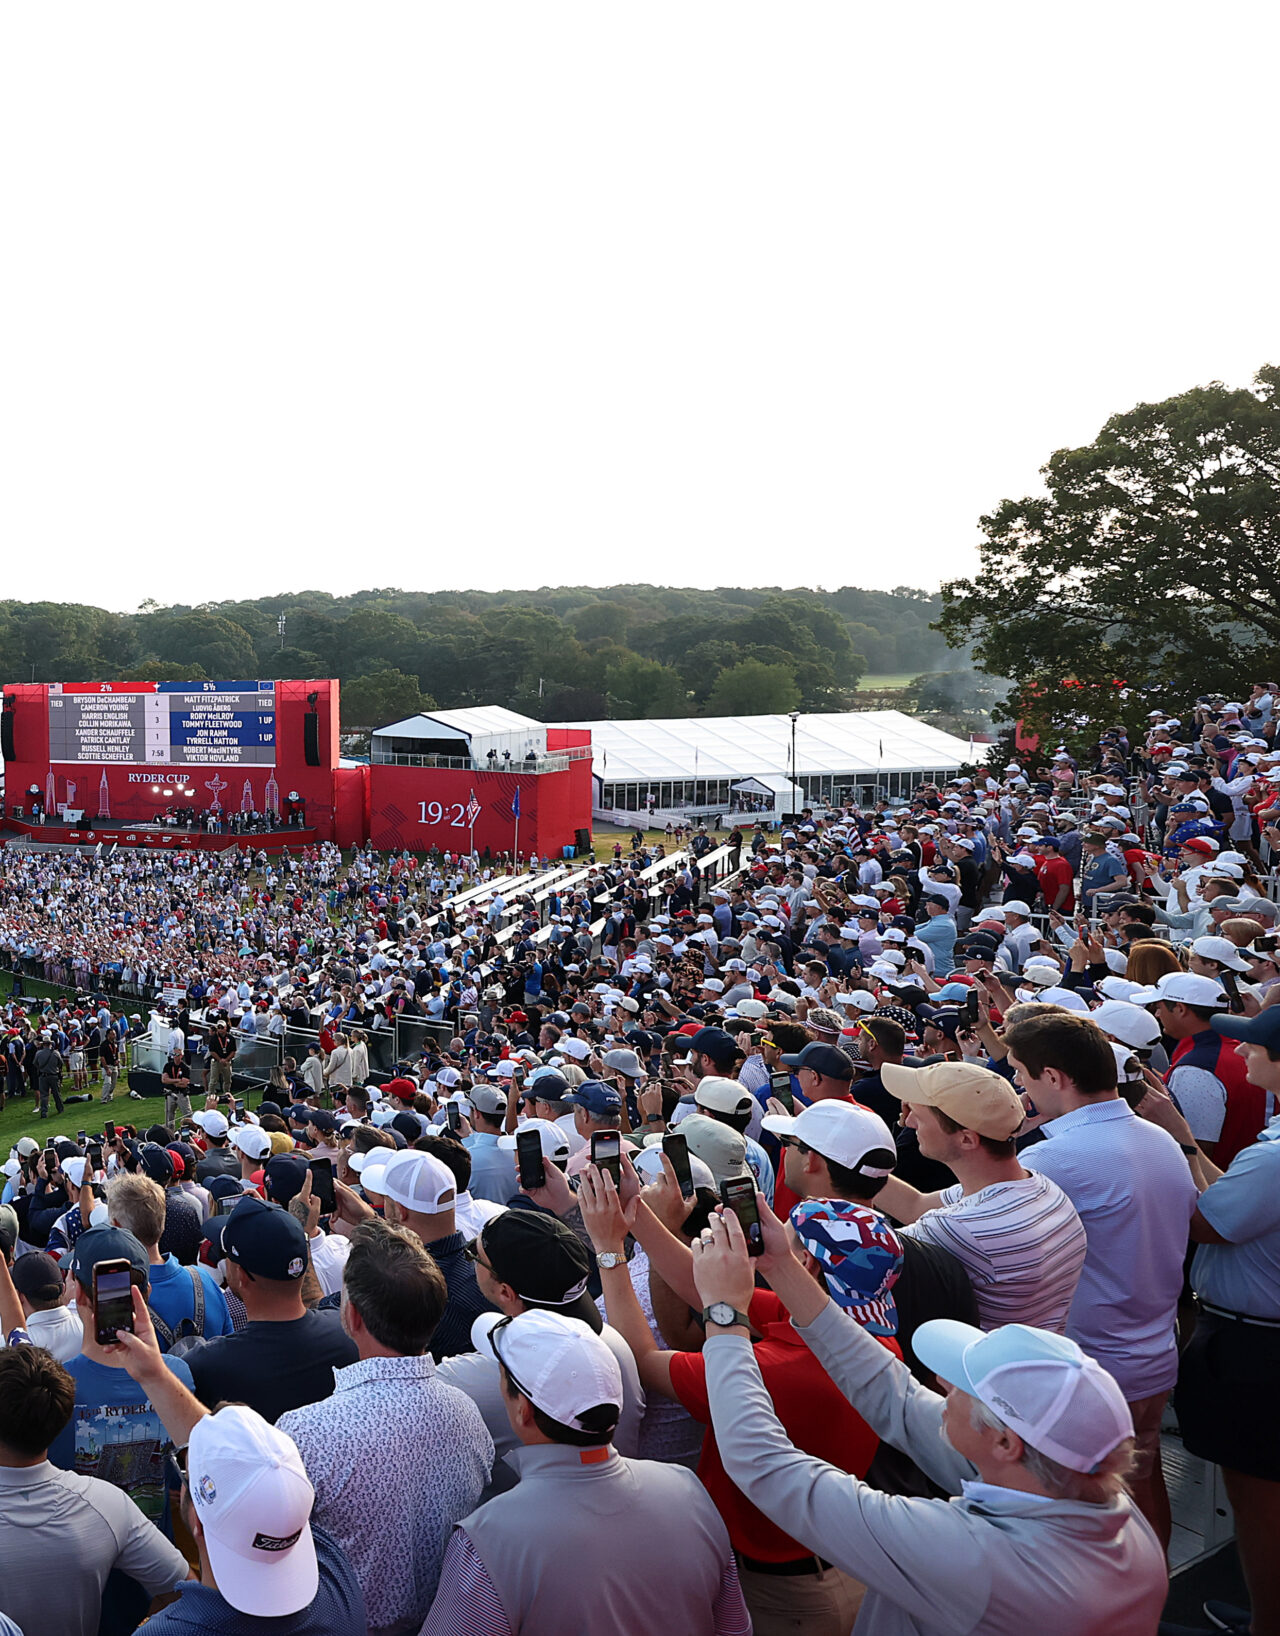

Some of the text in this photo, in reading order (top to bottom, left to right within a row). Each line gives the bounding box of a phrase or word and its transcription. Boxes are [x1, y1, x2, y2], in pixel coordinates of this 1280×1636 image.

[100, 684, 113, 692] 2½
[203, 683, 216, 691] 5½
[73, 696, 137, 704] BRYSON DeCHAMBEAU
[184, 695, 240, 703] MATT FITZPATRICK
[258, 699, 273, 707] TIED
[50, 700, 63, 708] TIED
[213, 703, 231, 712] ÅBERG
[81, 712, 103, 720] HARRIS
[190, 712, 207, 720] RORY
[263, 716, 273, 724] UP
[78, 720, 132, 728] COLLIN MORIKAWA
[205, 720, 243, 728] FLEETWOOD
[99, 729, 135, 737] SCHAUFFELE
[196, 729, 228, 737] JON RAHM
[263, 733, 273, 741] UP
[80, 736, 104, 744] PATRICK
[186, 737, 239, 745] TYRRELL HATTON
[107, 745, 130, 753] HENLEY
[183, 746, 242, 754] ROBERT MacINTYRE
[77, 752, 134, 760] SCOTTIE SCHEFFLER
[186, 754, 239, 762] VIKTOR HOVLAND
[128, 773, 190, 784] RYDER CUP
[105, 1404, 146, 1417] RYDER
